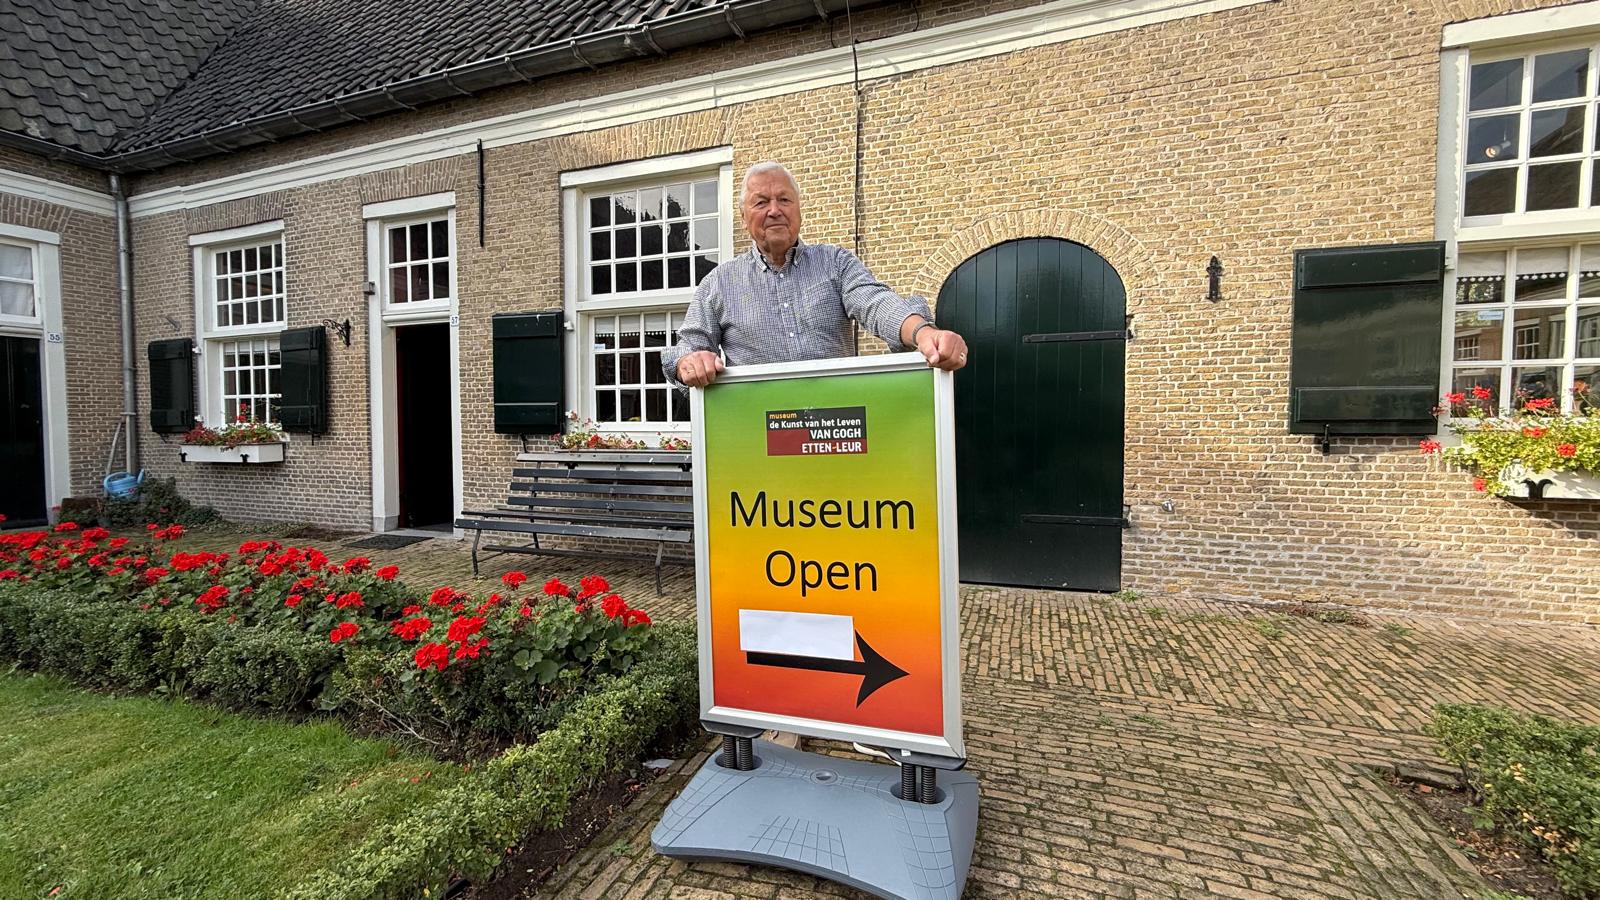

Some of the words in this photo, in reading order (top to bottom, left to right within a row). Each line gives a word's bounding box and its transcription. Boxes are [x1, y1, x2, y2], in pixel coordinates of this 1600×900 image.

[769, 412, 797, 420] museum
[769, 421, 779, 429] de
[781, 420, 803, 429] Kunst
[821, 418, 835, 427] het
[837, 418, 861, 427] Leven
[810, 429, 831, 440] VAN
[832, 428, 862, 439] GOGH
[802, 441, 862, 454] ETTEN-LEUR
[730, 490, 915, 530] Museum
[765, 549, 878, 598] Open
